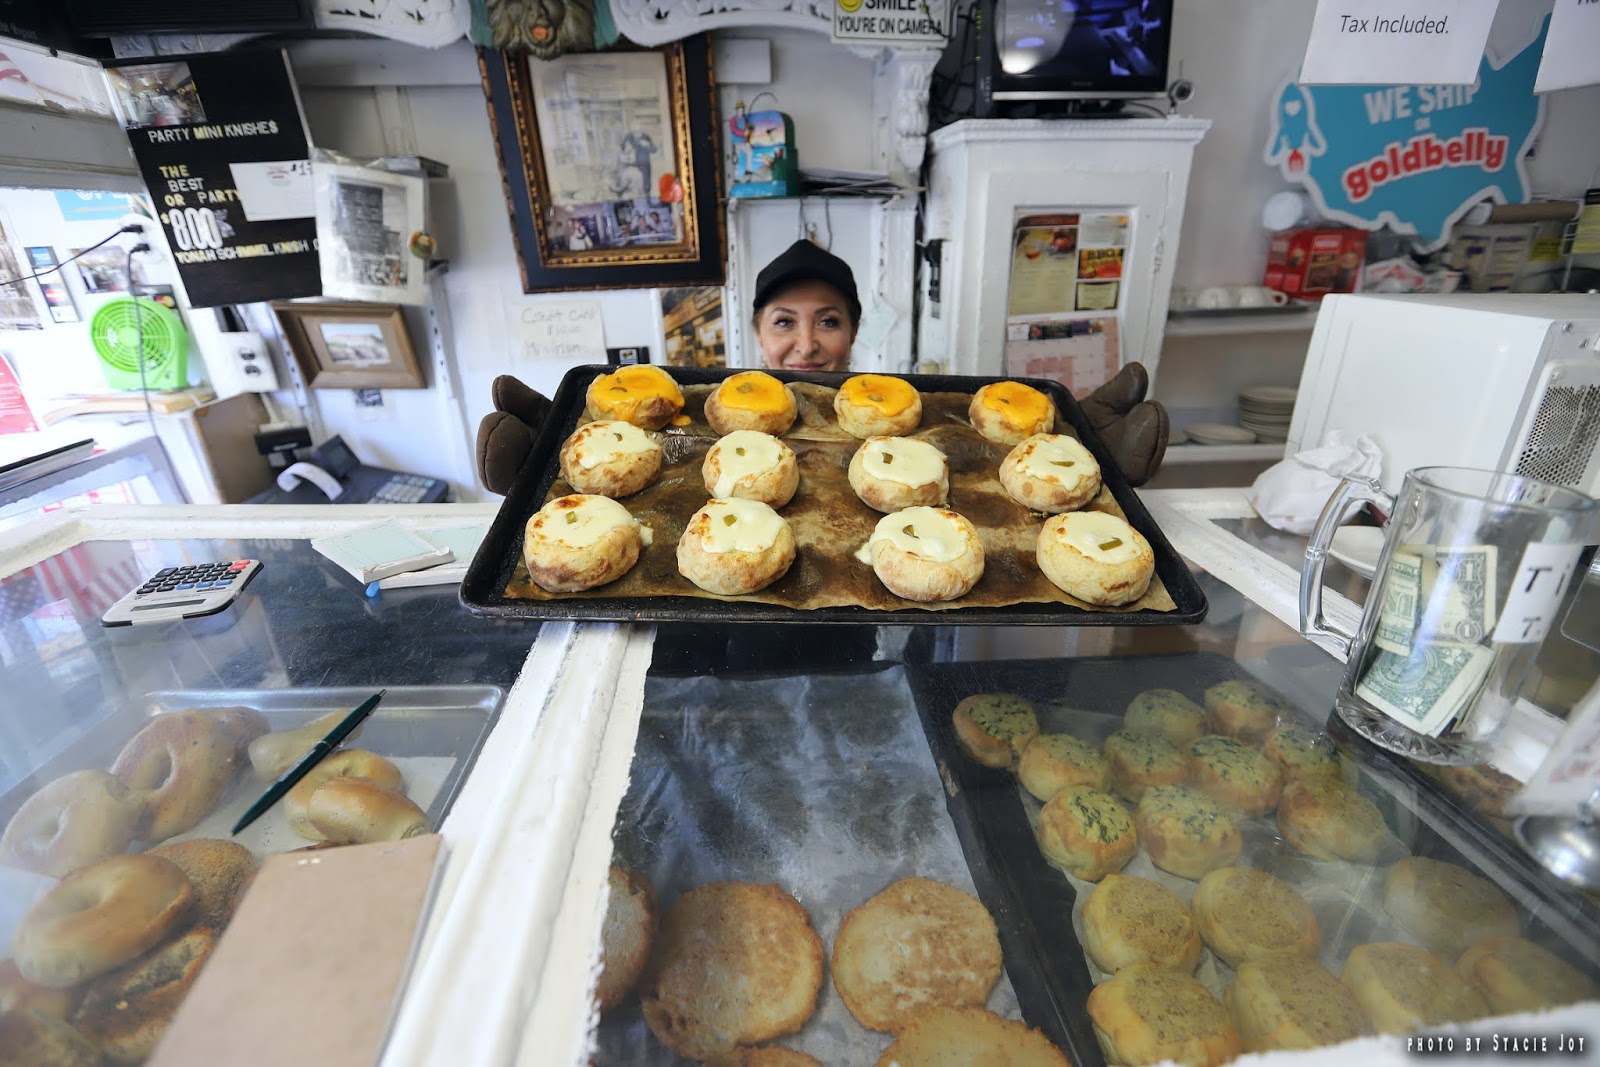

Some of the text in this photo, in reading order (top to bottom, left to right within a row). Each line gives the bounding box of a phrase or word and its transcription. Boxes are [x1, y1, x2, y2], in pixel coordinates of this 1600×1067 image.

[865, 0, 917, 10] SMILE
[838, 16, 943, 35] YOU'RE ON CAMERA
[1340, 15, 1449, 34] Tax Included.
[1363, 86, 1475, 125] WE SHIP
[148, 120, 279, 143] PARTY MINI KNISHES
[159, 164, 190, 178] THE
[1345, 131, 1506, 199] goldbelly
[167, 177, 204, 192] BEST
[164, 189, 241, 207] OR PARTY
[174, 250, 218, 265] YONAH
[272, 239, 310, 256] KNISH
